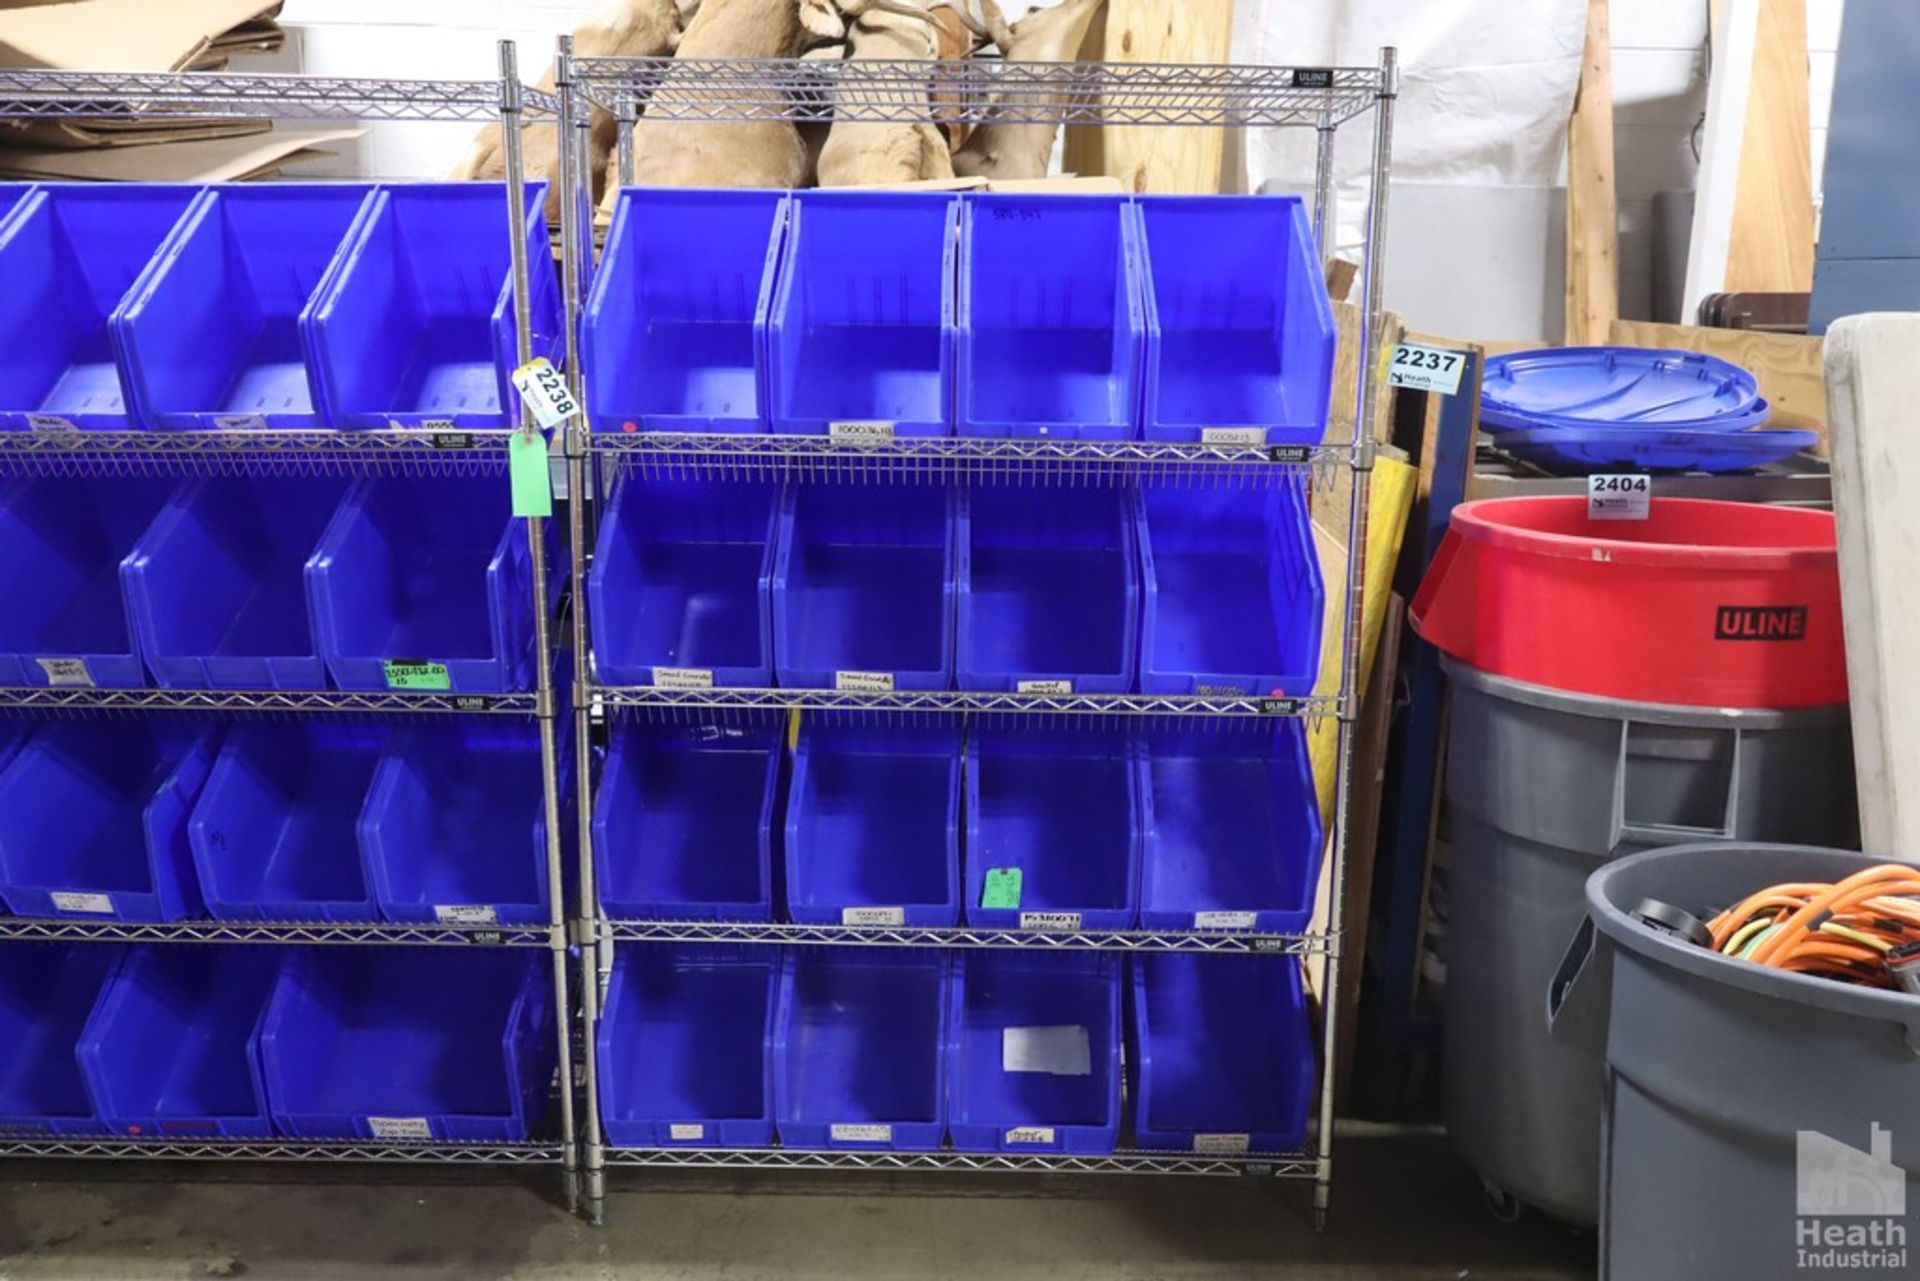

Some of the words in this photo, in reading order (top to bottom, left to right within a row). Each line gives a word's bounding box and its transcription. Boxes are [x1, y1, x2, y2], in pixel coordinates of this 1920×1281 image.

[1299, 72, 1328, 82] ULINE
[1395, 347, 1458, 373] 2237
[536, 367, 574, 414] 2238
[438, 434, 467, 444] ULINE
[1275, 447, 1305, 458] ULINE
[1593, 477, 1647, 493] 2404
[1721, 610, 1802, 636] ULINE
[456, 697, 485, 707] ULINE
[1264, 701, 1293, 711] ULINE
[473, 931, 501, 941] ULINE
